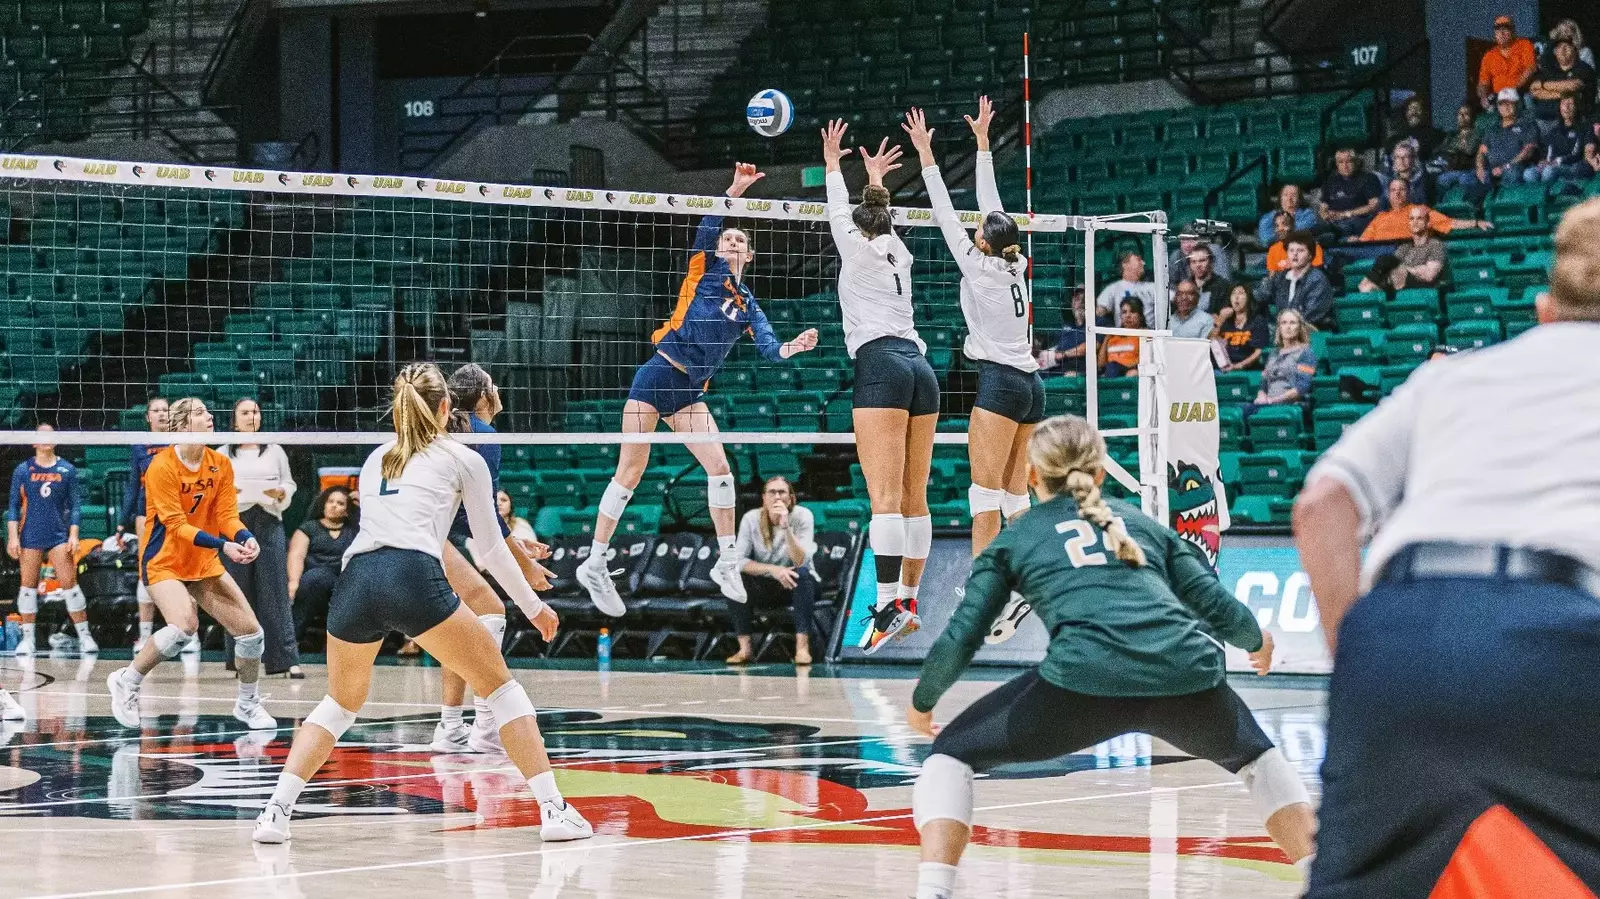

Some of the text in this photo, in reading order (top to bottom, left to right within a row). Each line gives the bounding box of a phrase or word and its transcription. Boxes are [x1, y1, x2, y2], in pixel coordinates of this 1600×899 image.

[1351, 45, 1378, 65] 107
[404, 100, 434, 117] 108
[2, 158, 38, 170] UAB
[83, 163, 117, 175] UAB
[156, 167, 190, 179] UAB
[233, 171, 265, 183] UAB
[303, 175, 333, 187] UAB
[373, 177, 403, 188] UAB
[436, 181, 466, 193] UAB
[502, 187, 532, 198] UAB
[566, 190, 594, 202] UAB
[629, 194, 657, 205] UAB
[686, 197, 714, 208] UAB
[746, 200, 771, 211] UAB
[893, 273, 902, 295] 1
[1010, 283, 1025, 317] 8
[1169, 402, 1217, 422] UAB
[31, 473, 62, 482] UTSA
[181, 478, 214, 493] USA
[40, 481, 52, 498] 6
[188, 493, 204, 514] 7
